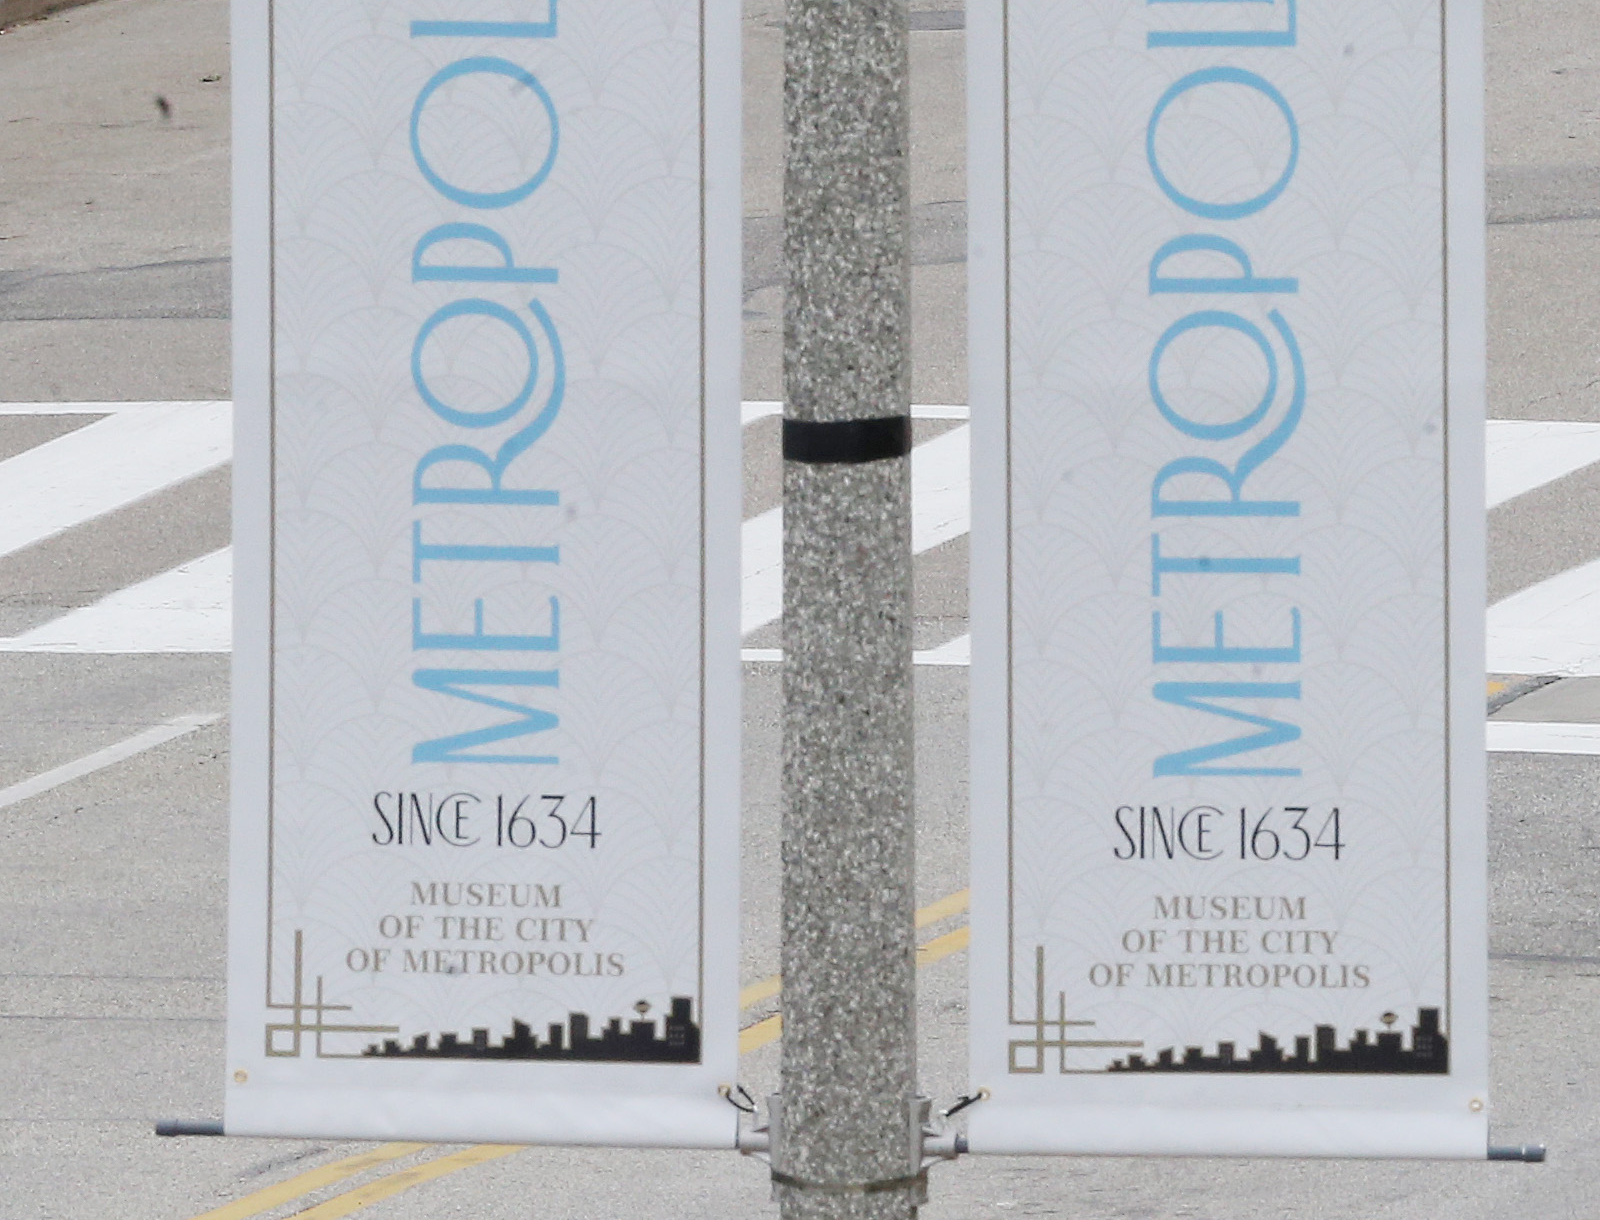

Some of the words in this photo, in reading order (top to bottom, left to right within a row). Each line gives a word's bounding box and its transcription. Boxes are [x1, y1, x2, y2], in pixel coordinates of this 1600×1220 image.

[372, 791, 481, 847] SINCE
[497, 794, 602, 849] 1634
[1114, 806, 1224, 860] SINCE
[1240, 807, 1345, 860] 1634
[413, 883, 560, 907] MUSEUM
[1154, 896, 1307, 920] MUSEUM
[379, 915, 421, 939] OF
[436, 916, 504, 941] THE
[516, 918, 593, 943] CITY
[1121, 930, 1167, 953] OF
[1178, 930, 1249, 954] THE
[1262, 931, 1339, 955] CITY
[346, 948, 390, 973] OF
[403, 950, 624, 976] METROPOLIS
[1089, 964, 1133, 986] OF
[1145, 964, 1370, 987] METROPOLIS
